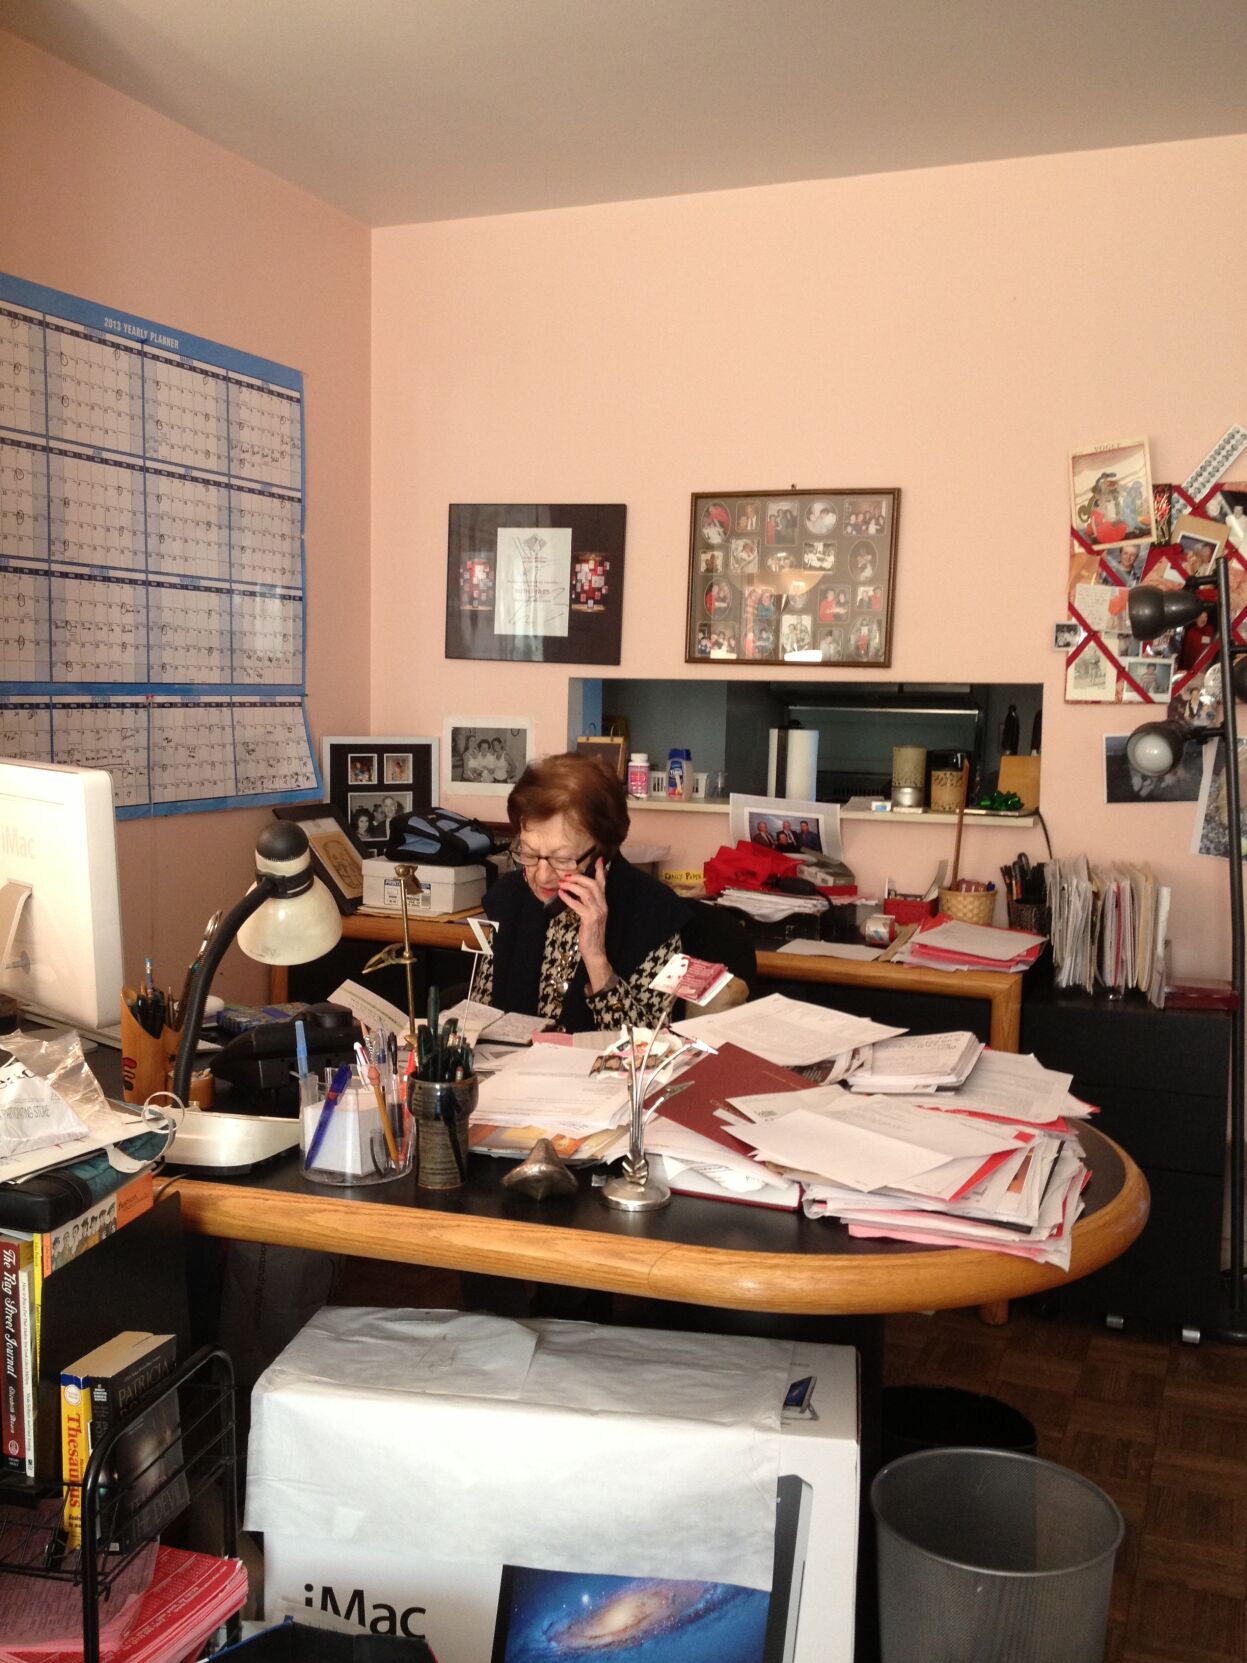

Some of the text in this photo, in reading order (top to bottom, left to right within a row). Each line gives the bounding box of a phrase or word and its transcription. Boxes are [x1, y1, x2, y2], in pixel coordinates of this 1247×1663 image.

[104, 316, 121, 331] 2013
[123, 323, 148, 339] YEARLY
[150, 331, 179, 350] PLANNER
[1, 823, 36, 861] iMac
[2, 1249, 18, 1379] The Rag Street Journal
[67, 1412, 82, 1508] Thesauus
[304, 1583, 426, 1639] iMac
